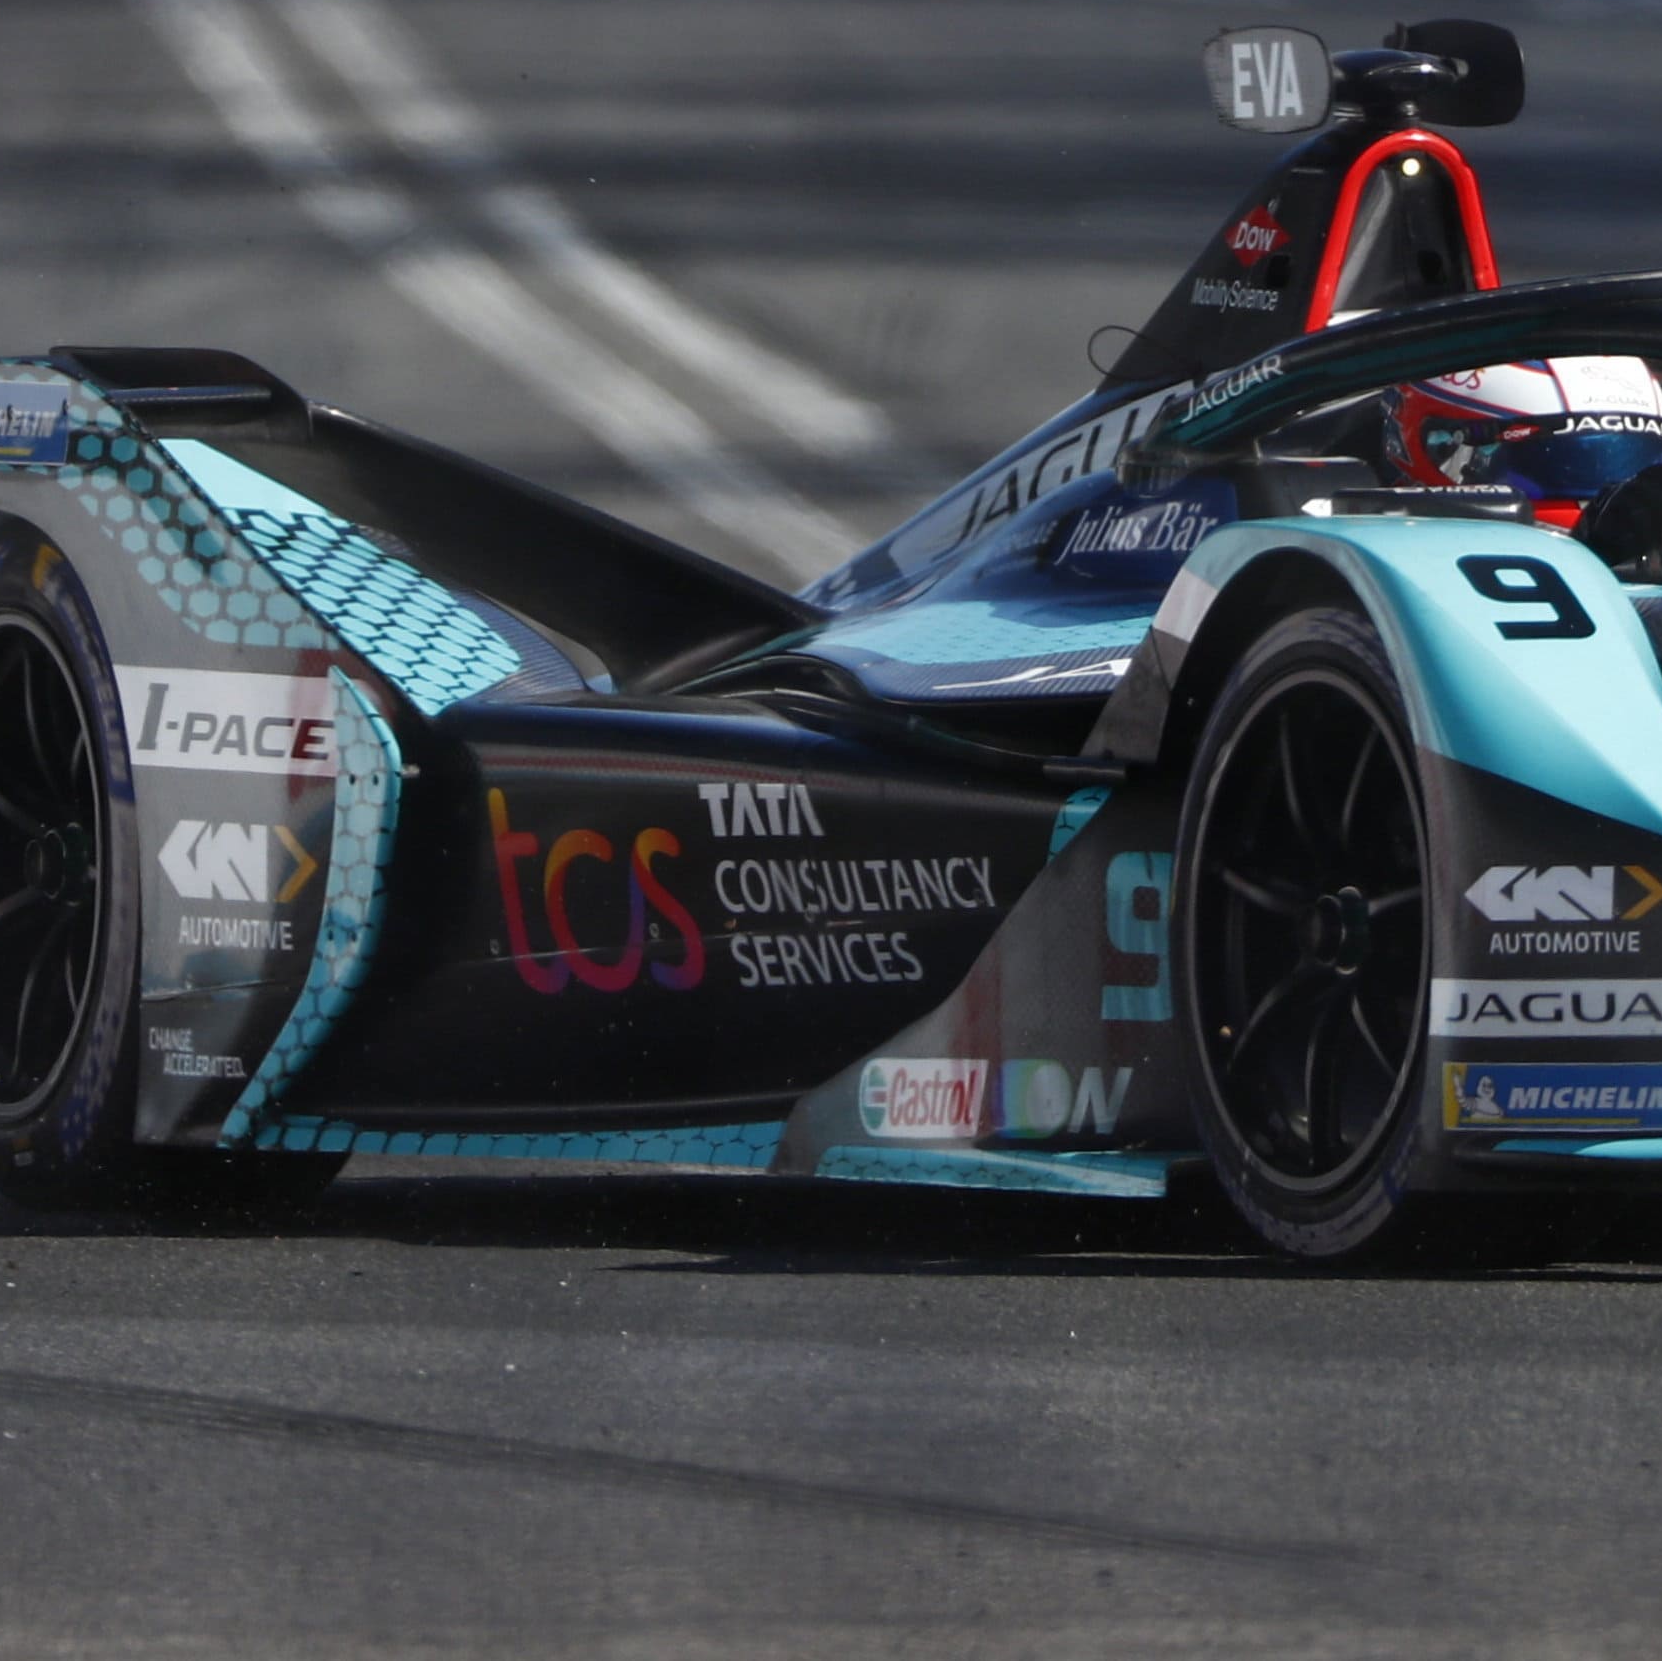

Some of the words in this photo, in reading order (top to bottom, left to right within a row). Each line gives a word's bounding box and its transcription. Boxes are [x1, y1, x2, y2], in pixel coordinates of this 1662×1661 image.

[1232, 42, 1303, 118] EVA
[1181, 354, 1283, 424] JAGUAR
[1054, 505, 1142, 565] Julius
[1457, 554, 1596, 639] 9
[136, 683, 335, 761] I-PACE
[699, 784, 825, 837] TATA
[488, 787, 705, 994] tcs
[715, 857, 996, 914] CONSULTANCY
[179, 916, 294, 950] AUTOMOTIVE
[730, 933, 923, 987] SERVICES
[1102, 851, 1174, 1021] 9
[1490, 932, 1640, 954] AUTOMOTIVE
[889, 1068, 979, 1127] Castrol
